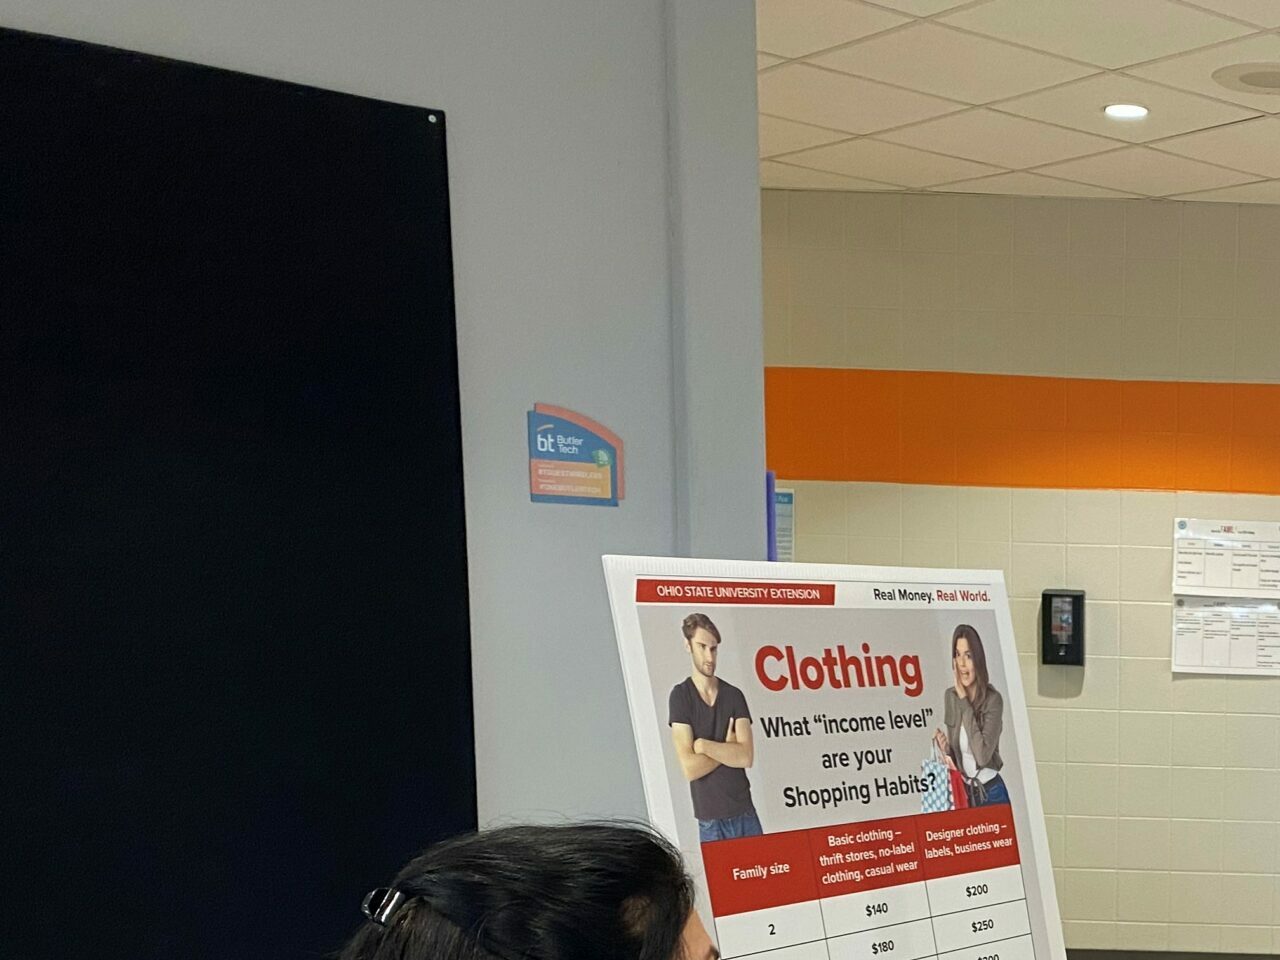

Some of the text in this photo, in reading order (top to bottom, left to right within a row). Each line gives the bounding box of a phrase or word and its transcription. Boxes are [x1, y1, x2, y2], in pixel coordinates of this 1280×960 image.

[537, 434, 555, 452] bt
[557, 435, 584, 446] Butler
[559, 445, 578, 454] Tech
[657, 585, 820, 600] OHIO STATE UNIVERSITY EXTENSION
[874, 588, 991, 604] Real Money. Real World.
[755, 642, 924, 697] Clothing
[760, 708, 934, 738] What “income level”
[822, 748, 892, 771] are your
[783, 773, 937, 809] Shopping Habits?
[828, 833, 854, 846] Basic
[856, 829, 894, 846] clothing
[926, 828, 964, 842] Designer
[965, 823, 1000, 838] clothing
[819, 842, 915, 867] thrift stores, no-label
[924, 838, 1012, 859] labels, business wear
[732, 862, 790, 882] Family size
[822, 860, 918, 884] clothing, casual wear
[966, 884, 988, 898] $200
[865, 902, 888, 917] $140
[768, 924, 776, 936] 2
[972, 919, 994, 934] $250
[872, 940, 894, 955] $180
